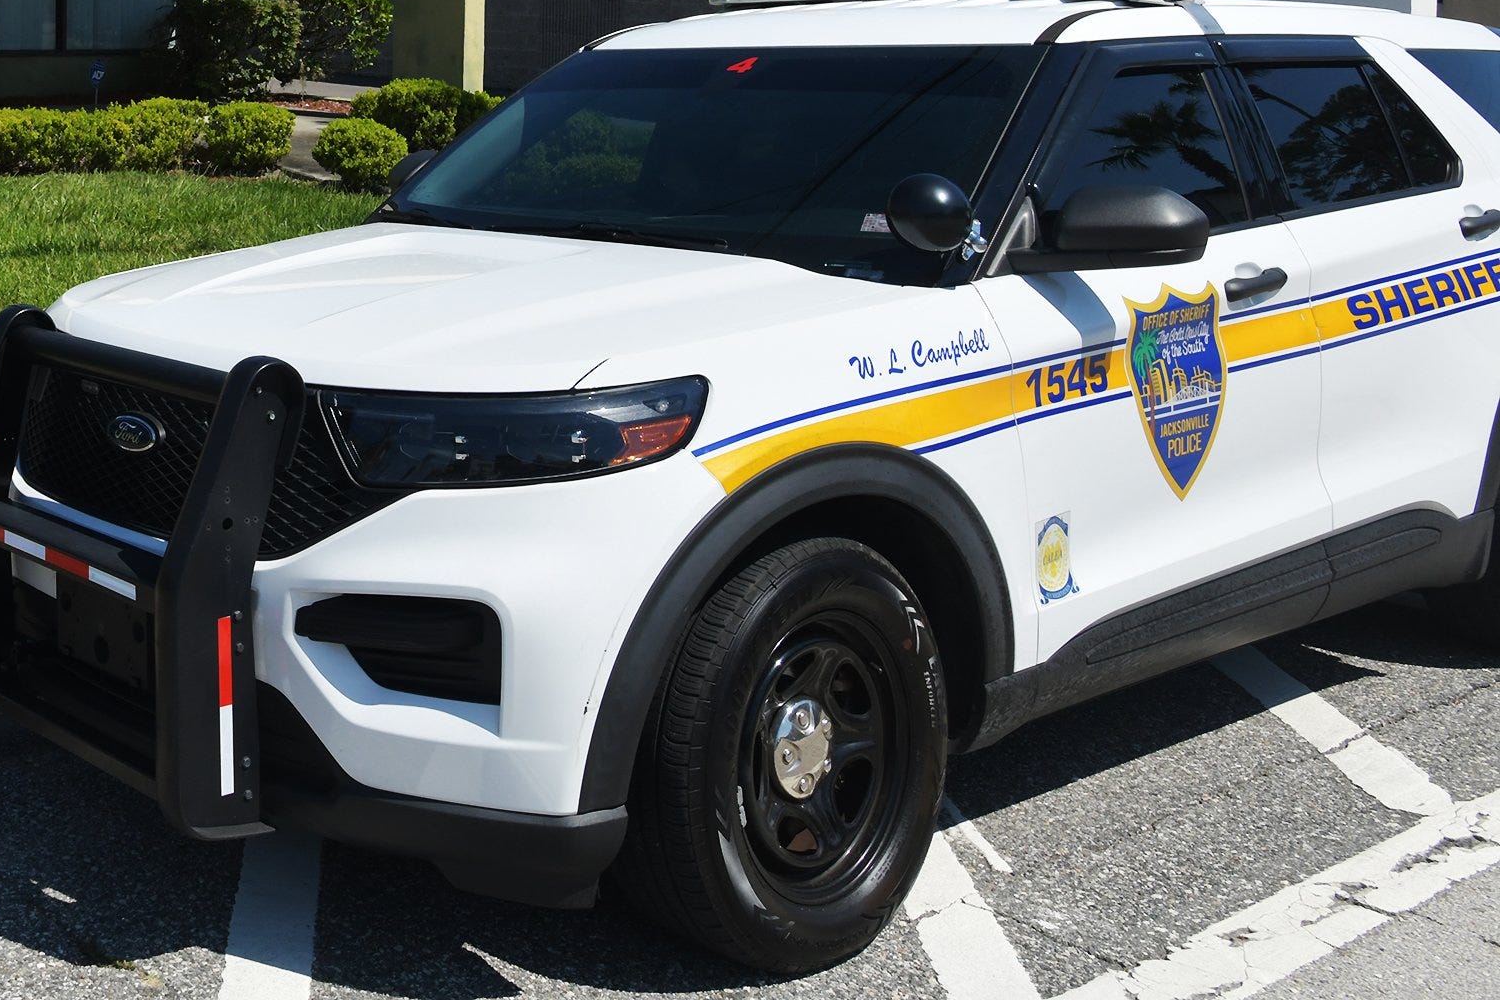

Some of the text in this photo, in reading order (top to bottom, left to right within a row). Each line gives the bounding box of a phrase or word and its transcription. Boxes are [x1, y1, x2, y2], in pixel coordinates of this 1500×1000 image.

[1143, 303, 1211, 331] OFFICE OF SHERIFF
[1156, 330, 1169, 345] The
[849, 355, 883, 379] W.
[911, 328, 990, 368] Campbell
[1162, 338, 1206, 365] of the South
[1026, 352, 1109, 407] 1545
[1160, 414, 1209, 438] JACKSONVILLE
[1168, 432, 1202, 458] POLICE
